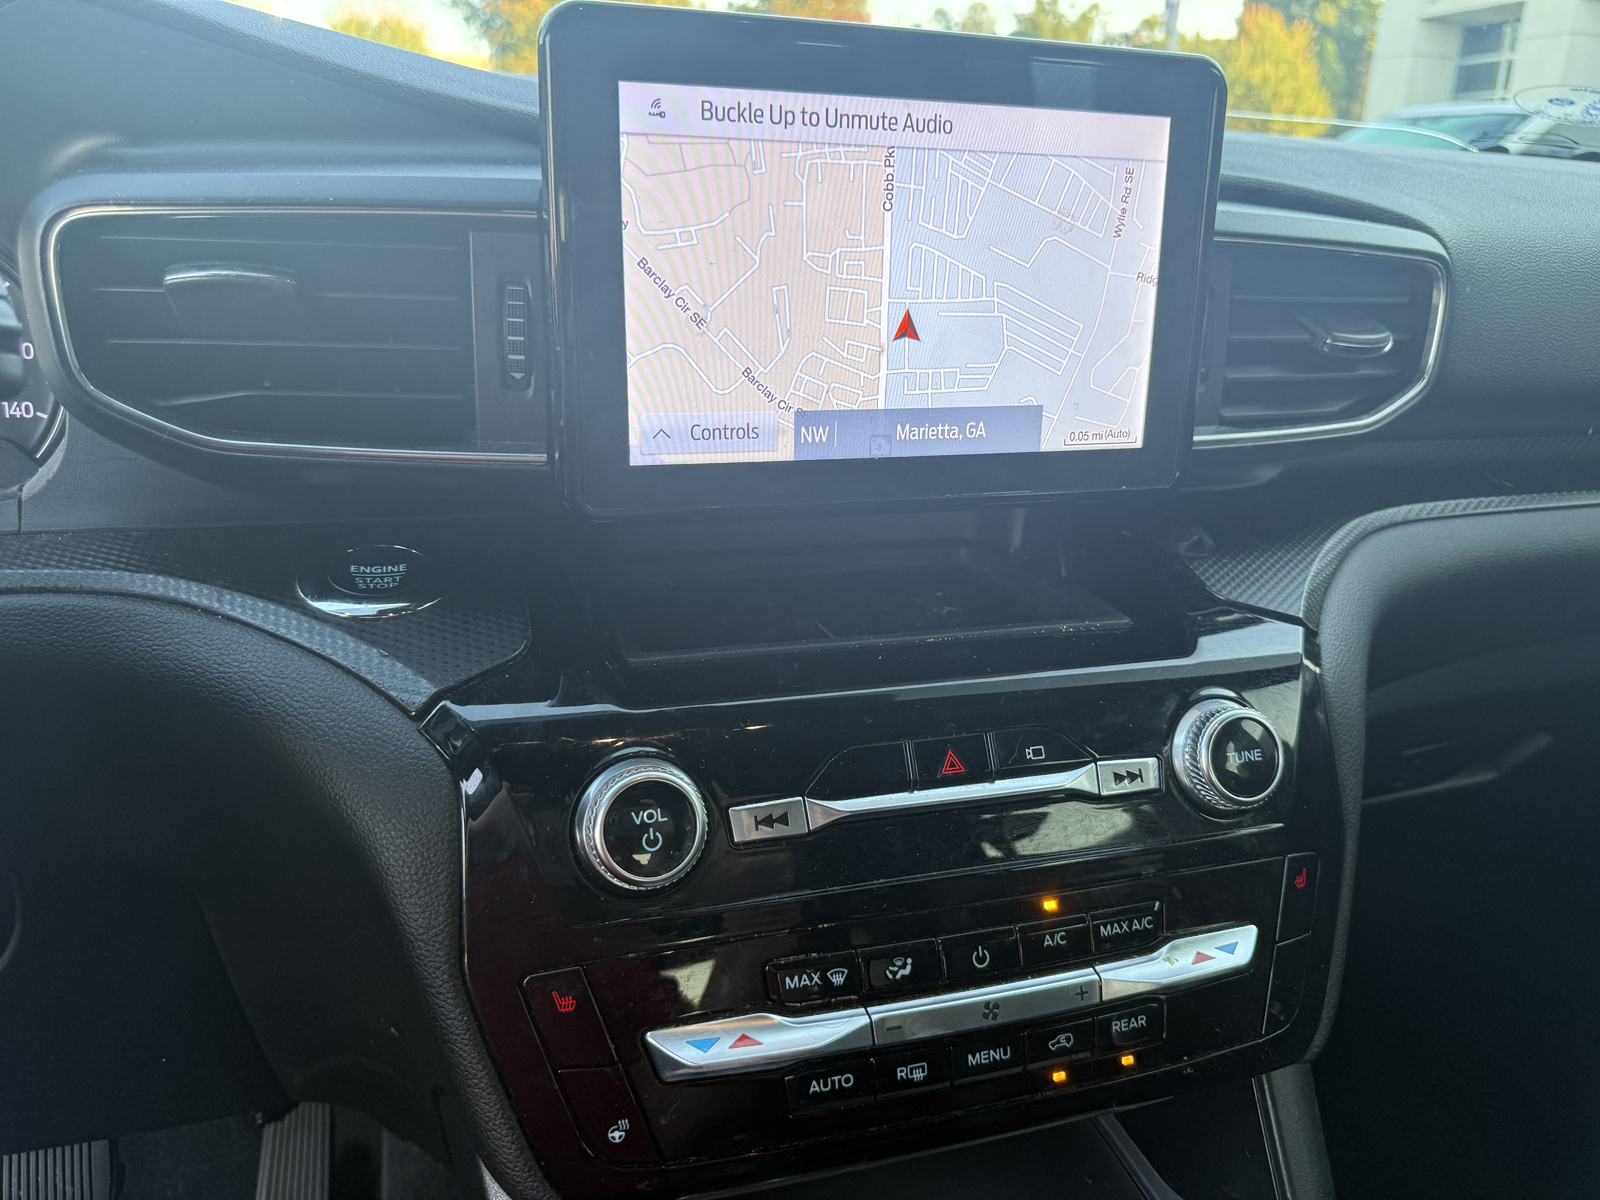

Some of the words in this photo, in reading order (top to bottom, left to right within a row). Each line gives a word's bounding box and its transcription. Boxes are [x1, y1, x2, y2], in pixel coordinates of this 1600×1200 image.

[701, 100, 764, 124] Buckle
[769, 104, 796, 129] Up
[802, 109, 820, 127] to
[825, 107, 898, 132] Unmute
[902, 113, 953, 135] Audio
[1124, 166, 1135, 184] SE
[882, 173, 895, 212] Cobb
[1121, 187, 1132, 204] Rd
[1113, 207, 1127, 238] Wylie
[637, 257, 675, 299] Barclay
[675, 296, 691, 314] Cir
[690, 312, 707, 330] SE
[741, 367, 777, 403] Barclay
[777, 399, 794, 413] Cir
[2, 401, 34, 418] 140
[690, 422, 759, 441] Controls
[801, 425, 830, 443] NW
[896, 423, 962, 441] Marietta,
[966, 423, 986, 439] GA
[1069, 430, 1089, 442] 0.05
[350, 563, 408, 573] ENGINE
[355, 576, 403, 584] START
[1226, 748, 1263, 764] TUNE
[631, 808, 668, 825] VOL
[1100, 920, 1131, 938] MAX
[1131, 916, 1154, 931] A/C
[1043, 932, 1067, 948] A/C
[785, 971, 821, 990] MAX
[1112, 1014, 1147, 1034] REAR
[968, 1046, 1011, 1067] MENU
[809, 1073, 854, 1095] AUTO
